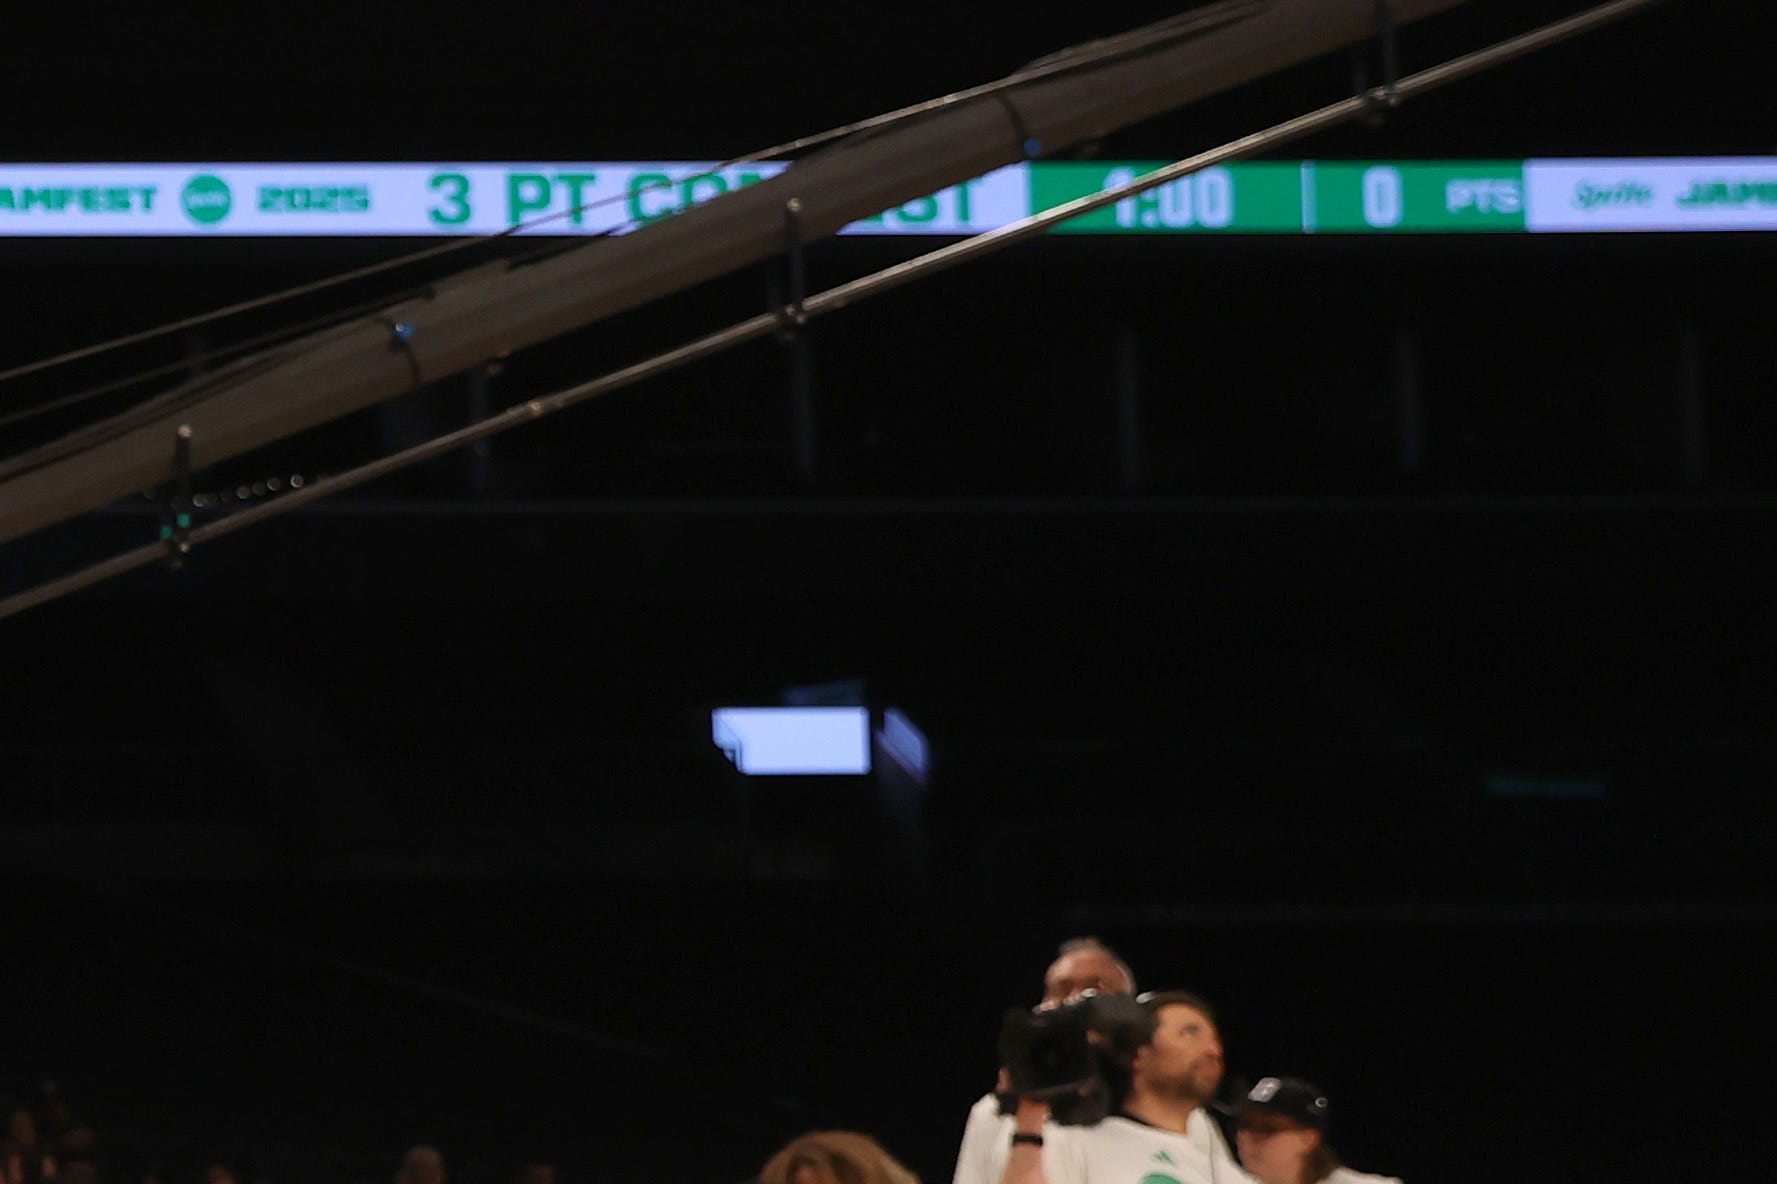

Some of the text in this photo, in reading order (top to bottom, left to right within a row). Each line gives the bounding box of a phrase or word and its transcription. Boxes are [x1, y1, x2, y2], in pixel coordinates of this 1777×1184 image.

[257, 183, 371, 213] 2025
[429, 172, 472, 226] 3
[507, 172, 597, 228] PT
[1445, 178, 1522, 215] PTS
